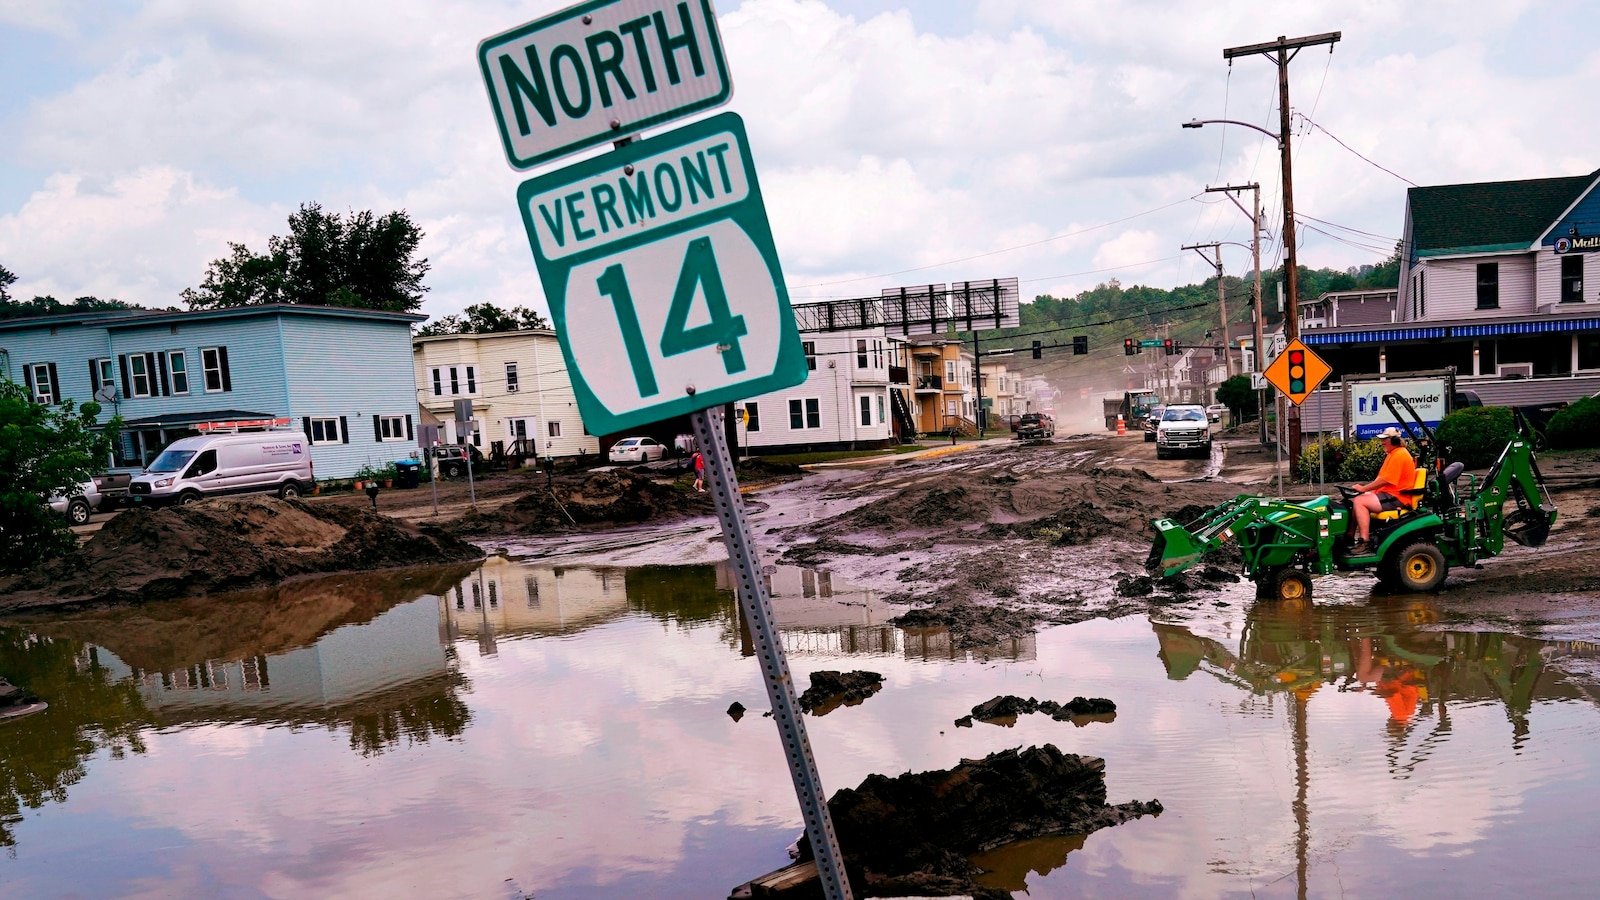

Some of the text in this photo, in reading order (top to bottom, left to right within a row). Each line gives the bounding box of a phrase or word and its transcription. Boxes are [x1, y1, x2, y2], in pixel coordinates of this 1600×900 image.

[499, 2, 705, 136] NORTH
[538, 143, 729, 248] VERMONT
[596, 236, 747, 398] 14
